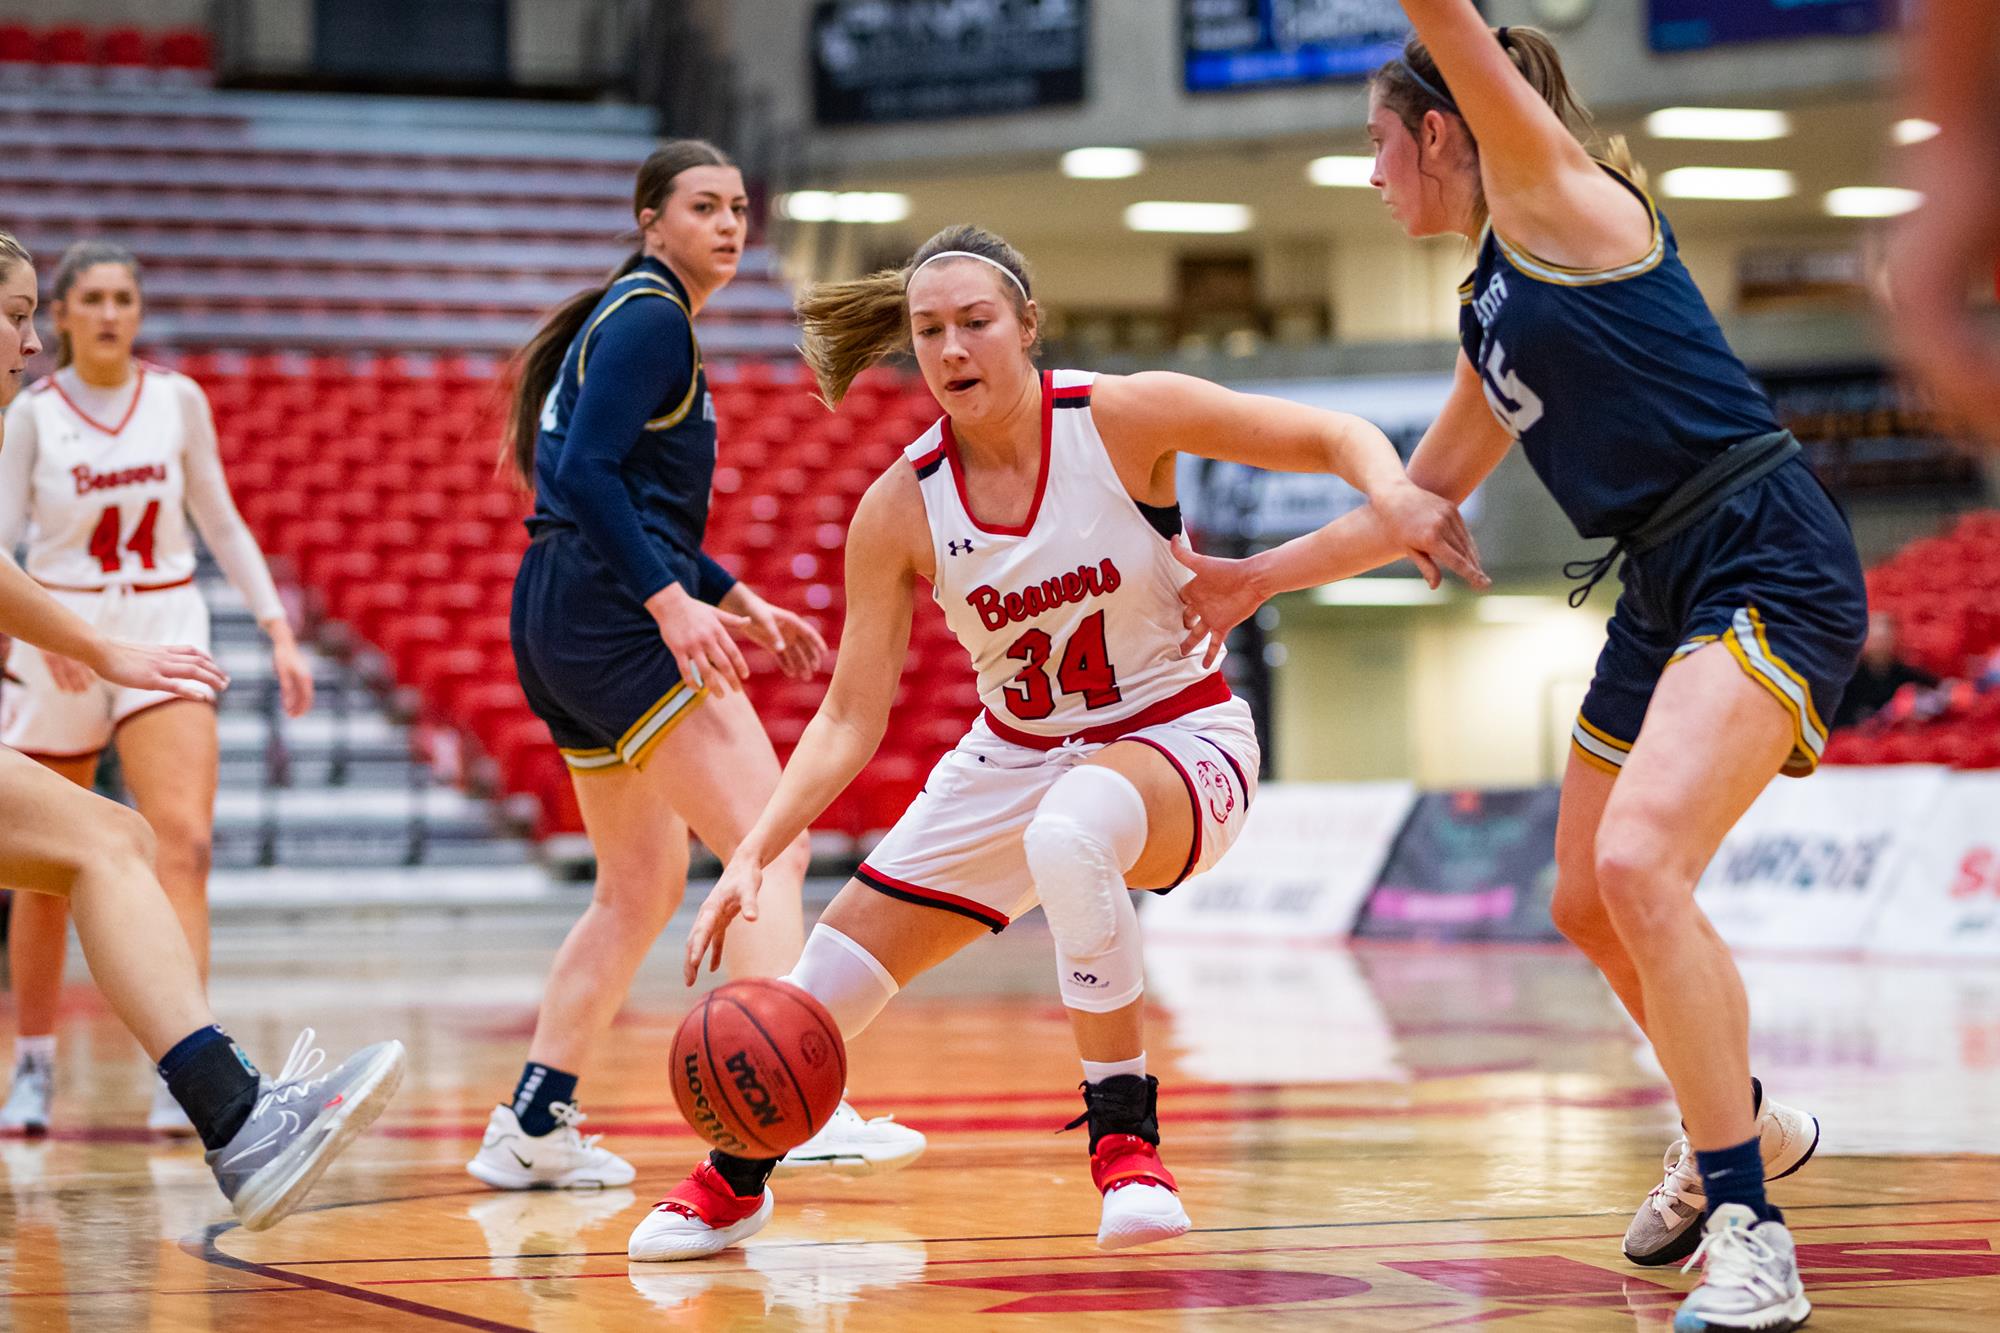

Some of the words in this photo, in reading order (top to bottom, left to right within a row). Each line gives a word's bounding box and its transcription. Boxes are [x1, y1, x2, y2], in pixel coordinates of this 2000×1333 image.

[88, 500, 161, 574] 44
[966, 557, 1122, 632] Beavers
[1003, 608, 1123, 720] 34
[684, 1051, 748, 1151] Wilson
[725, 1050, 785, 1129] NCAA
